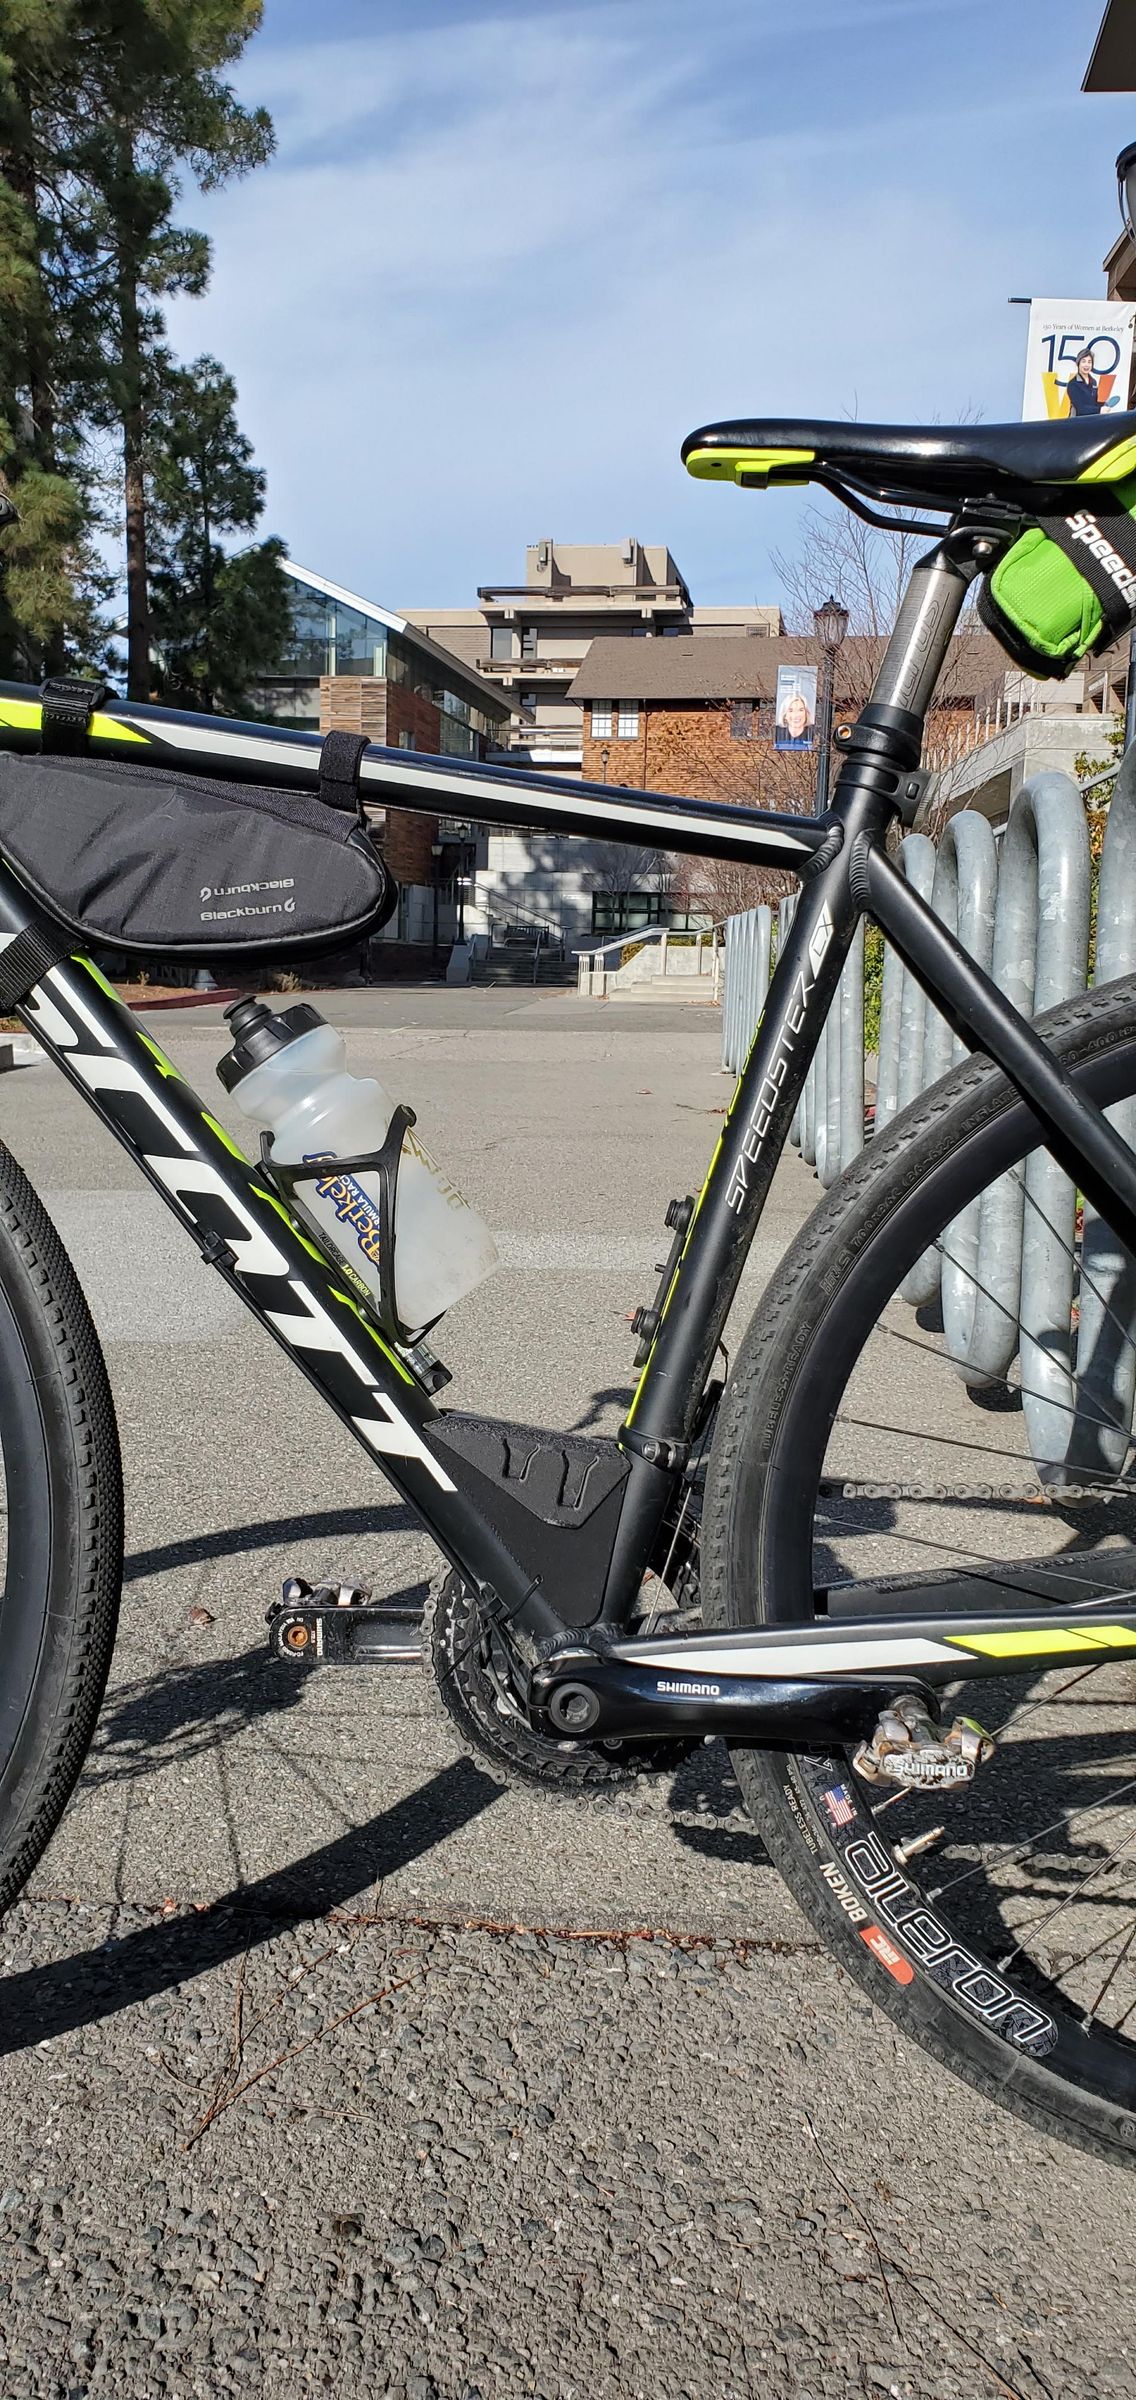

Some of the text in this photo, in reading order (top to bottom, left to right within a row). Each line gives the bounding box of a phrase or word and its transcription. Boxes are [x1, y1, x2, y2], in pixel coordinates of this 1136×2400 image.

[1053, 323, 1066, 331] Years
[1102, 325, 1125, 333] Berkeley
[1041, 334, 1121, 388] 150
[214, 878, 295, 896] Blackburn
[200, 904, 282, 921] Blackburn
[724, 971, 816, 1215] SPEEDSTER
[349, 1272, 371, 1297] CARBON
[656, 1681, 720, 1696] SHIMANO
[894, 1762, 968, 1777] SHIMANO
[782, 1784, 818, 1855] TUBELESS READY
[819, 1861, 868, 1923] BOKEN
